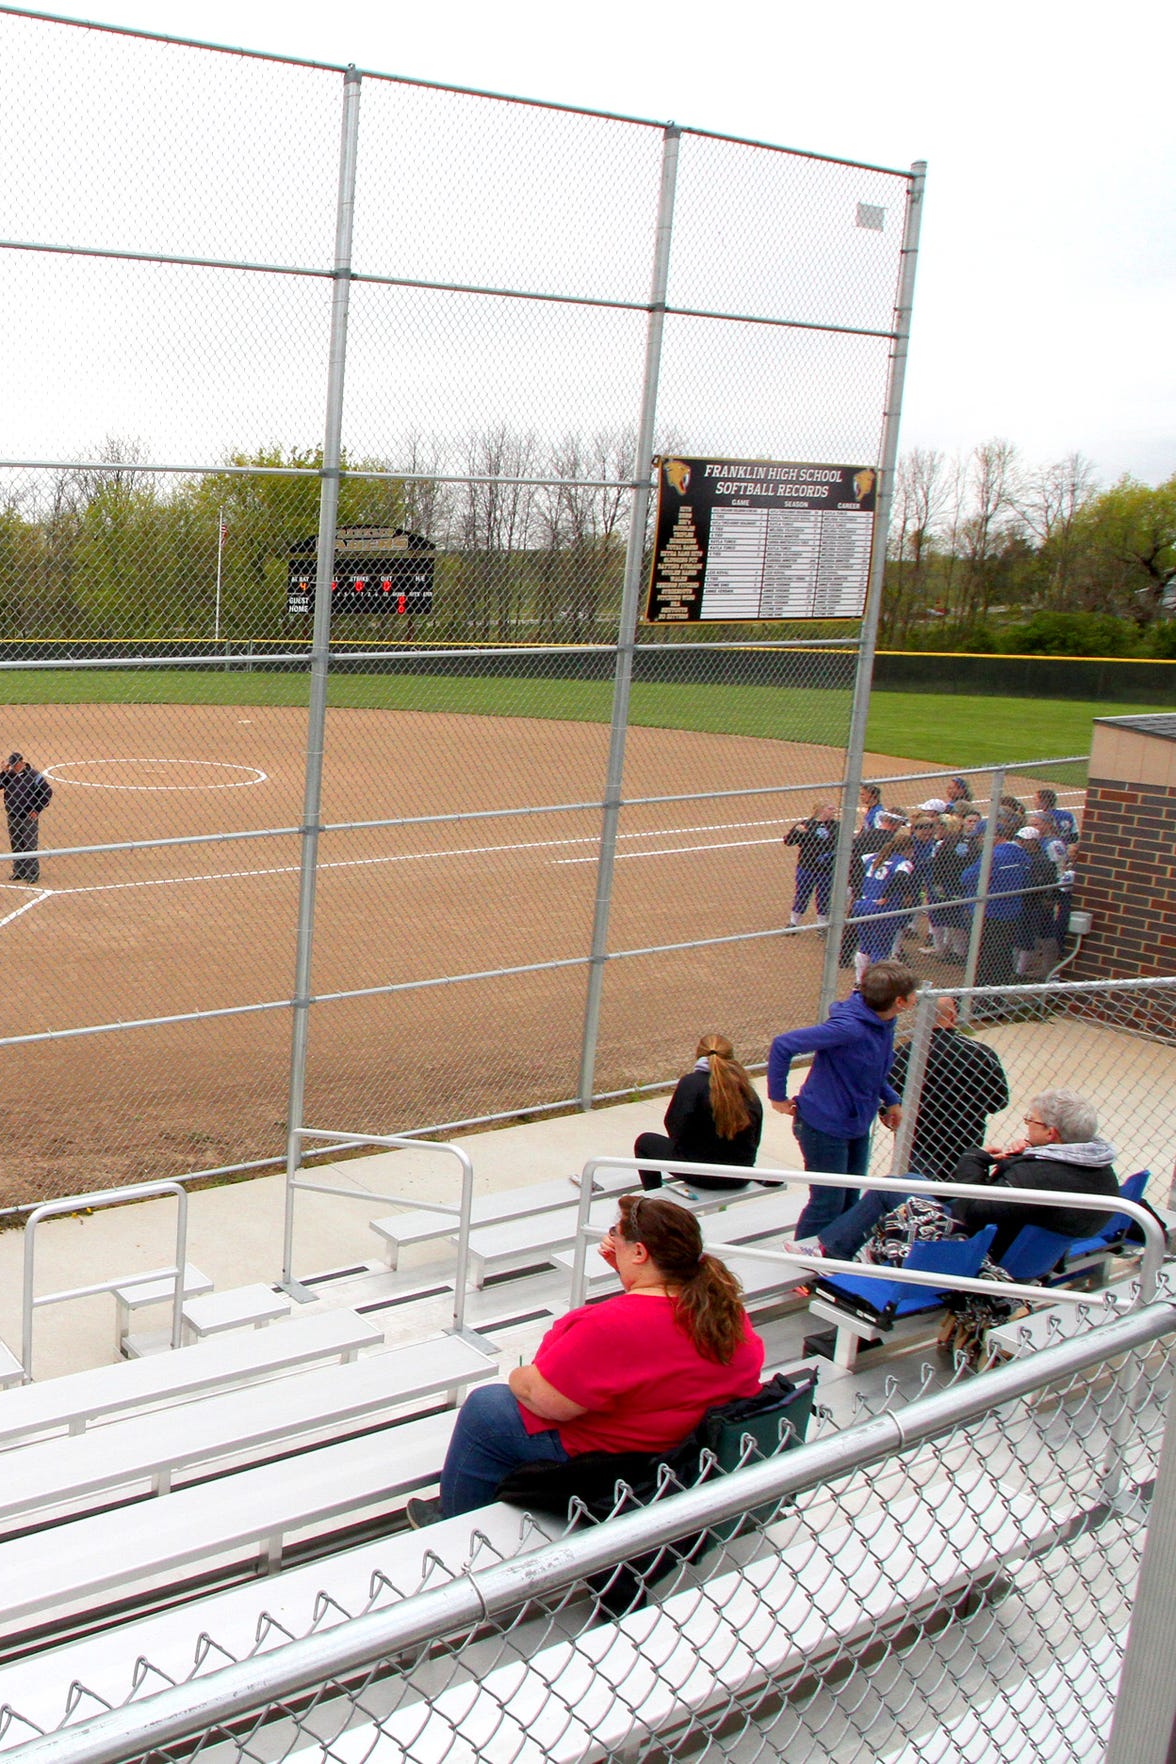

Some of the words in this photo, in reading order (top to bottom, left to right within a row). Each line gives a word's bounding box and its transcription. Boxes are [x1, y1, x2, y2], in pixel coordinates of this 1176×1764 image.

[704, 464, 767, 480] FRANKLIN
[768, 468, 799, 482] HIGH
[799, 469, 843, 483] SCHOOL
[715, 481, 775, 496] SOFTBALL
[777, 484, 829, 498] RECORDS
[731, 499, 750, 507] GAME
[784, 500, 809, 508] SEASON
[837, 502, 861, 510] CAREER
